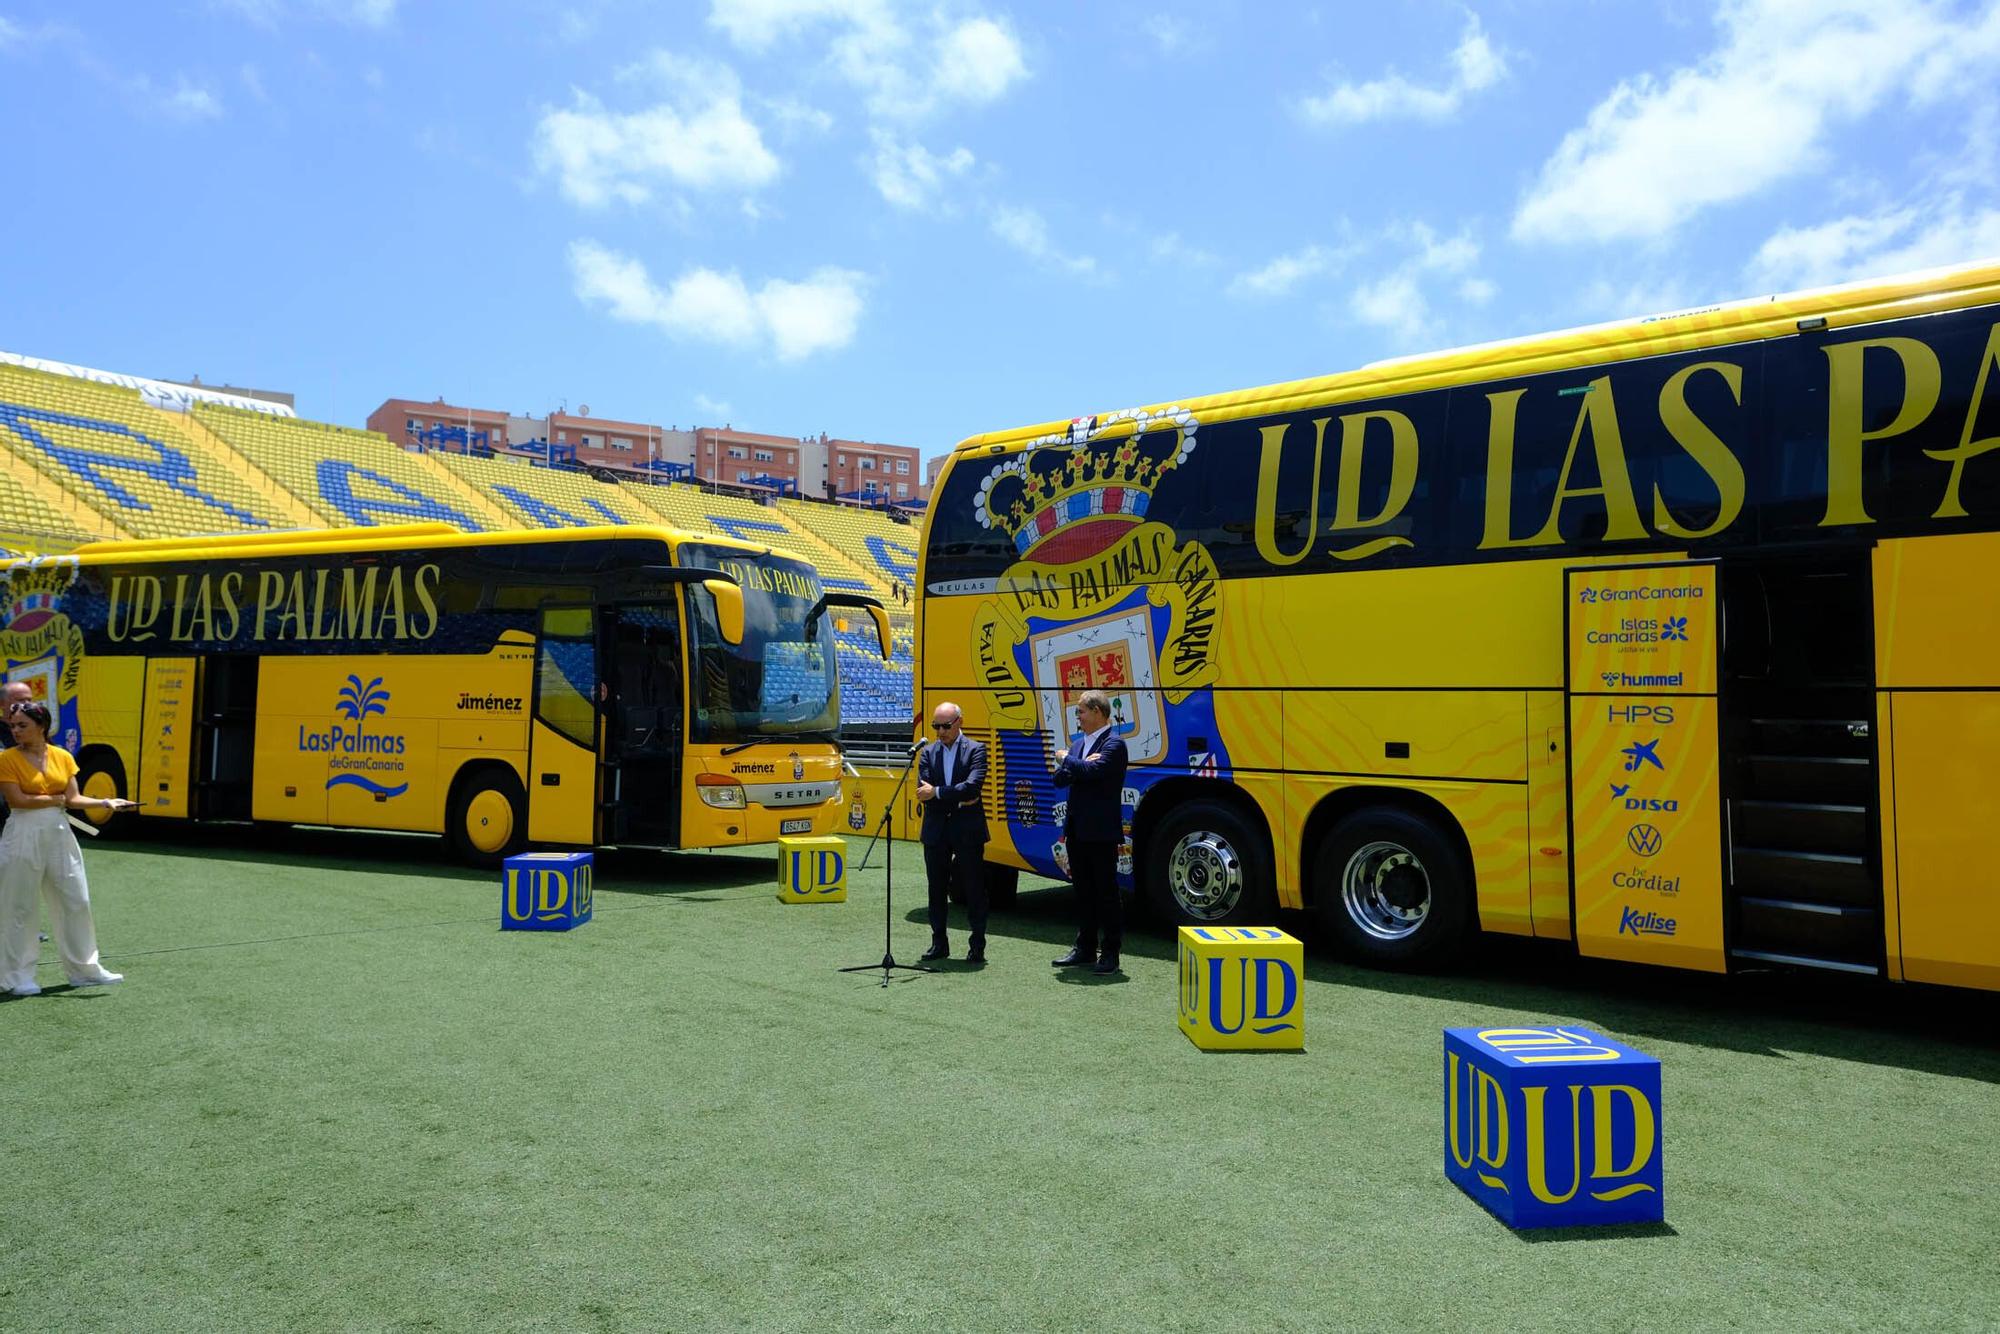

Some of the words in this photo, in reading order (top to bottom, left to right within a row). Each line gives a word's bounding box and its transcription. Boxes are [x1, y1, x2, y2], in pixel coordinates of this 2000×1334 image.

[1253, 410, 1420, 566] UD
[1477, 362, 1746, 549] LAS
[746, 565, 773, 592] LAS
[773, 569, 820, 602] PALMAS
[938, 582, 985, 592] BEULAS
[1009, 570, 1060, 612] LAS
[1069, 531, 1165, 609] PALMAS
[107, 575, 162, 642] UD
[169, 571, 243, 642] LAS
[254, 564, 441, 641] PALMAS
[1600, 584, 1703, 601] GranCanaria
[1169, 551, 1217, 676] CANARIAS
[1621, 618, 1658, 630] Islas
[1587, 631, 1658, 644] Canarias
[1621, 672, 1683, 686] hummel
[457, 693, 522, 710] Jiménez
[1608, 704, 1674, 724] HPS
[299, 723, 405, 754] LasPalmas
[330, 756, 404, 771] deGranCanaria
[731, 761, 775, 774] Jiménez
[774, 789, 821, 799] SETRA
[791, 850, 843, 895] UD
[1613, 872, 1680, 892] Cordial
[506, 869, 568, 921] UD
[1619, 905, 1677, 936] Kalise
[1206, 957, 1297, 1035] UD
[1448, 1050, 1510, 1195] UD
[1520, 1083, 1656, 1205] UD
